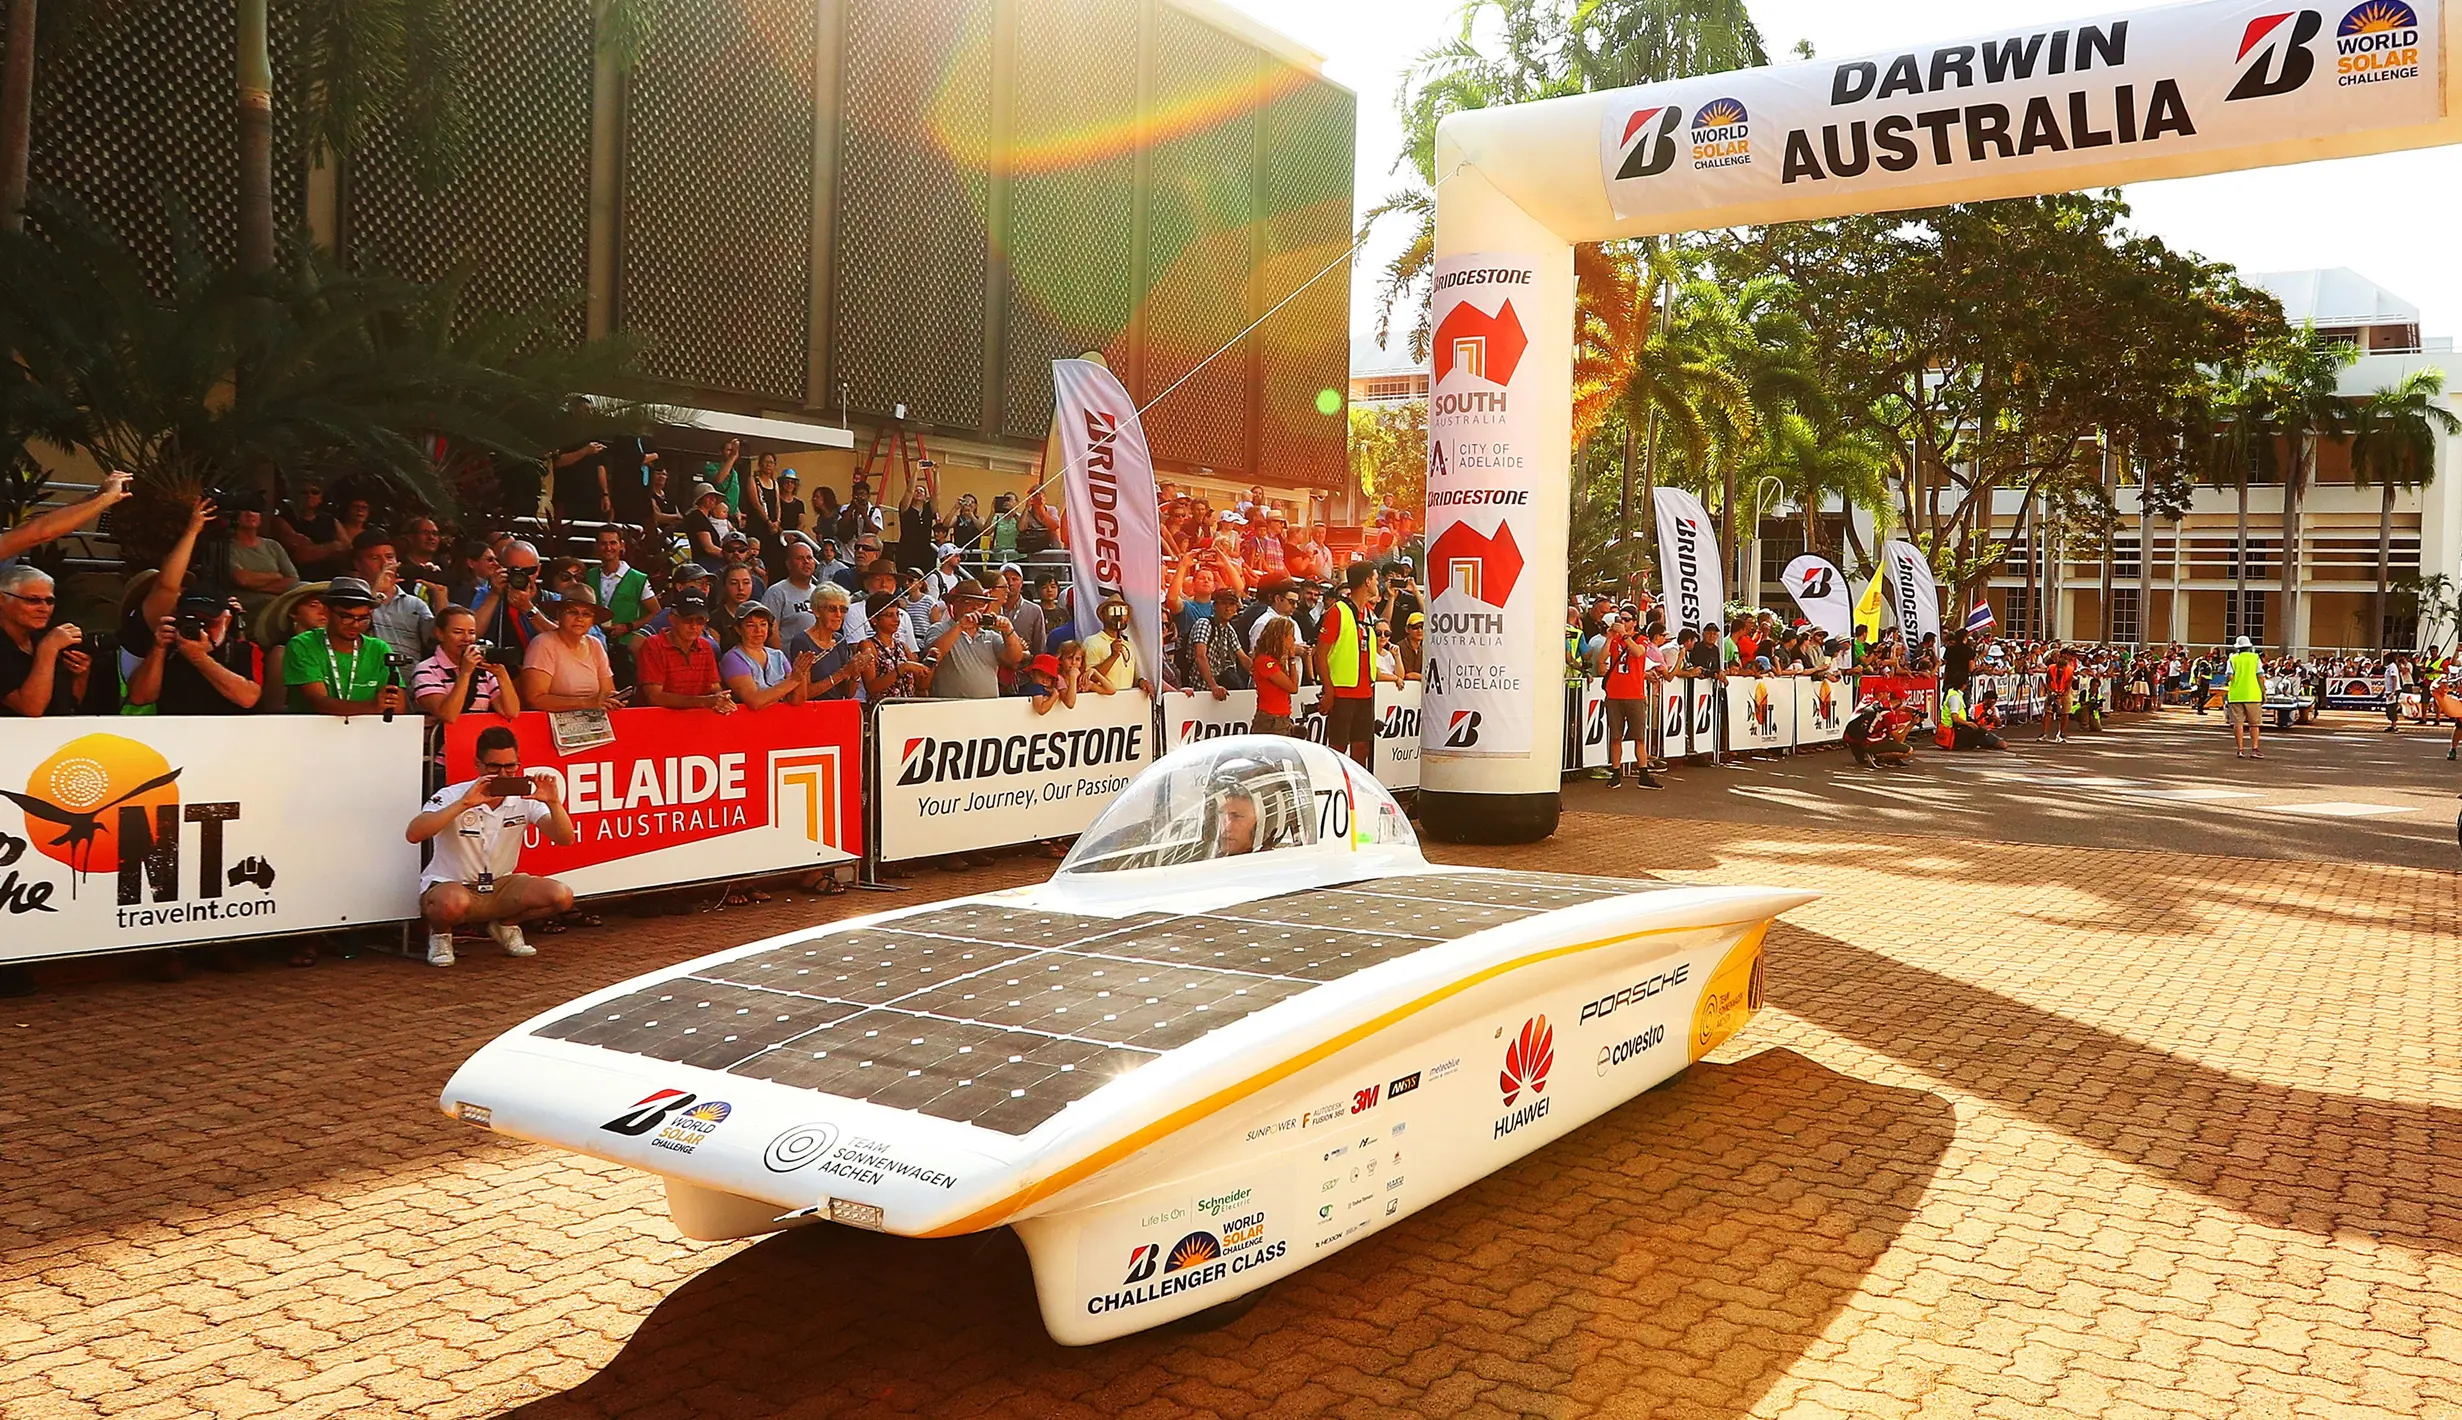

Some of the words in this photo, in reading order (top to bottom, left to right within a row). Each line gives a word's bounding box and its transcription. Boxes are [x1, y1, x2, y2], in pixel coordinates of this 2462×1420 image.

[2337, 30, 2419, 55] WORLD
[1831, 20, 2129, 106] DARWIN
[2337, 48, 2419, 75] SOLAR
[2338, 67, 2419, 87] CHALLENGE
[1692, 125, 1749, 144] WORLD
[1781, 78, 2197, 185] AUSTRALIA
[1692, 140, 1750, 161] SOLAR
[1694, 155, 1751, 171] CHALLENGE
[1436, 392, 1507, 416] SOUTH
[1435, 415, 1506, 427] AUSTRALIA
[1459, 444, 1487, 455] CITY
[1493, 444, 1510, 454] OF
[1459, 456, 1524, 468] ADELAIDE
[1431, 613, 1503, 634] SOUTH
[1430, 636, 1503, 646] AUSTRALIA
[1455, 665, 1482, 677] CITY
[1490, 666, 1506, 677] OF
[1455, 678, 1520, 690] ADELAIDE
[896, 724, 1143, 786] BRIDGESTONE
[1392, 747, 1414, 761] Your
[523, 752, 747, 815] DELAIDE
[918, 796, 961, 817] Your
[964, 787, 1037, 812] Journey,
[1043, 782, 1072, 801] Our
[1076, 774, 1130, 796] Passion
[597, 805, 747, 841] AUSTRALIA
[1314, 789, 1349, 839] 70
[117, 802, 240, 906] NT
[0, 870, 59, 914] he
[117, 897, 276, 928] travelnt.com
[1579, 963, 1690, 1025] PORSCHE
[1612, 1023, 1665, 1066] covestro
[1313, 1102, 1342, 1117] AUTODESK
[1351, 1084, 1380, 1115] 3M
[671, 1116, 717, 1134] WORLD
[1246, 1118, 1297, 1141] SUNPOWER
[1312, 1113, 1333, 1126] FUSION
[1494, 1096, 1550, 1140] HUAWEI
[651, 1138, 696, 1155] CHALLENGE
[658, 1126, 705, 1146] SOLAR
[847, 1135, 892, 1154] TEAM
[818, 1161, 885, 1187] AACHEN
[832, 1147, 958, 1190] SONNENWAGEN
[1198, 1188, 1252, 1211] Schneider
[1221, 1199, 1251, 1213] Electric
[1141, 1215, 1159, 1228] Life
[1170, 1208, 1186, 1220] On
[1223, 1211, 1265, 1234] WORLD
[1223, 1224, 1264, 1247] SOLAR
[1223, 1236, 1264, 1256] CHALLENGE
[1087, 1262, 1227, 1315] CHALLENGER
[1232, 1240, 1287, 1275] CLASS
